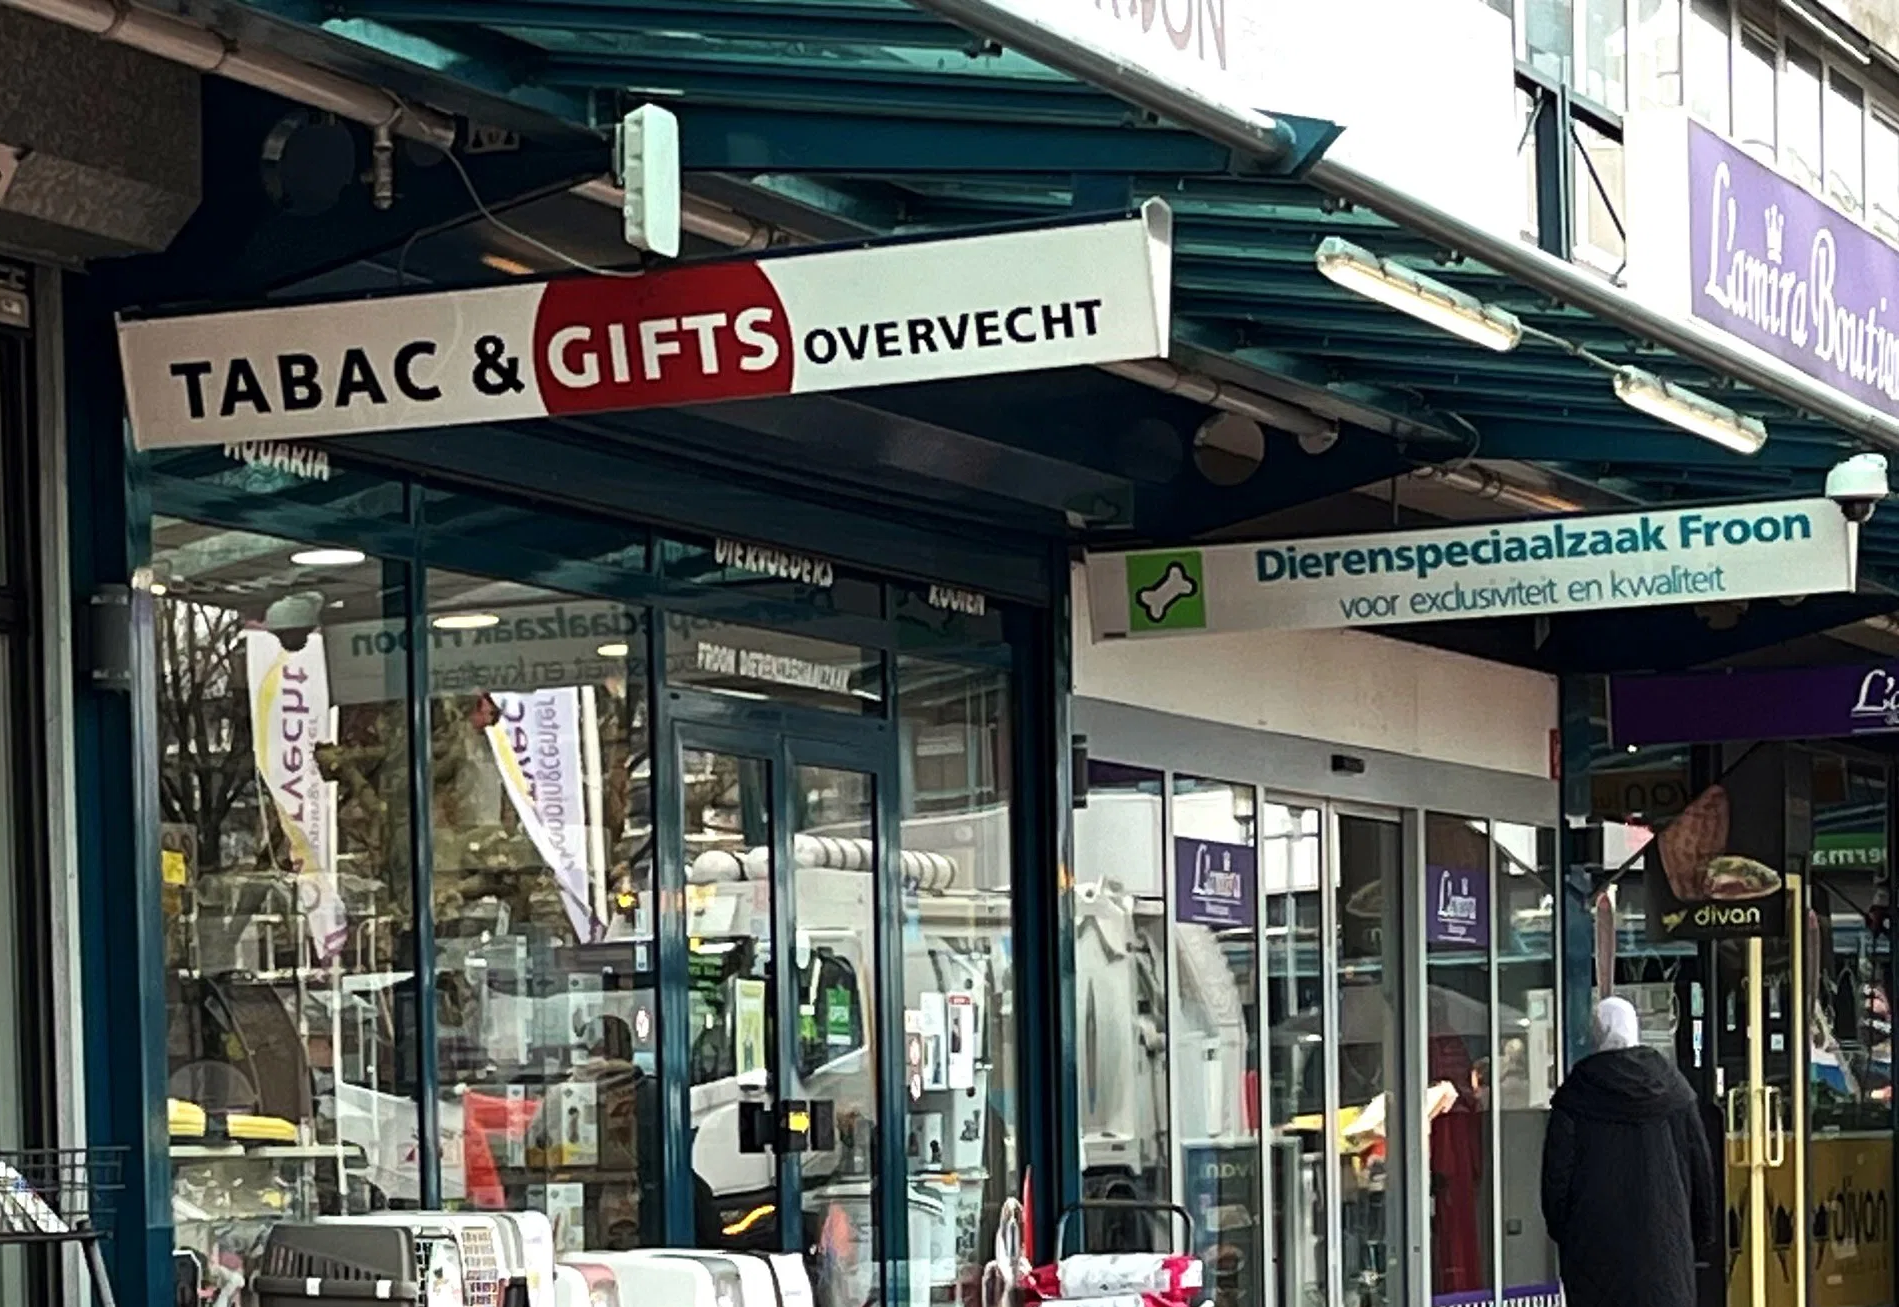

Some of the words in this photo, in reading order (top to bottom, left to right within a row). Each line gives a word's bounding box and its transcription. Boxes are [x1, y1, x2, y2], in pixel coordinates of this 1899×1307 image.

[1704, 161, 1807, 347] L'amira
[170, 340, 442, 420] TABAC
[471, 333, 526, 396] &
[546, 306, 781, 390] GIFTS
[802, 297, 1103, 367] OVERVECHT
[1255, 515, 1669, 584] Dierenspeciaalzaak
[1679, 509, 1811, 550] Froon
[1339, 591, 1401, 621] voor
[1410, 576, 1558, 614] exclusiviteit
[1567, 577, 1604, 602] en
[1609, 565, 1726, 599] kwaliteit
[1694, 905, 1761, 927] divan
